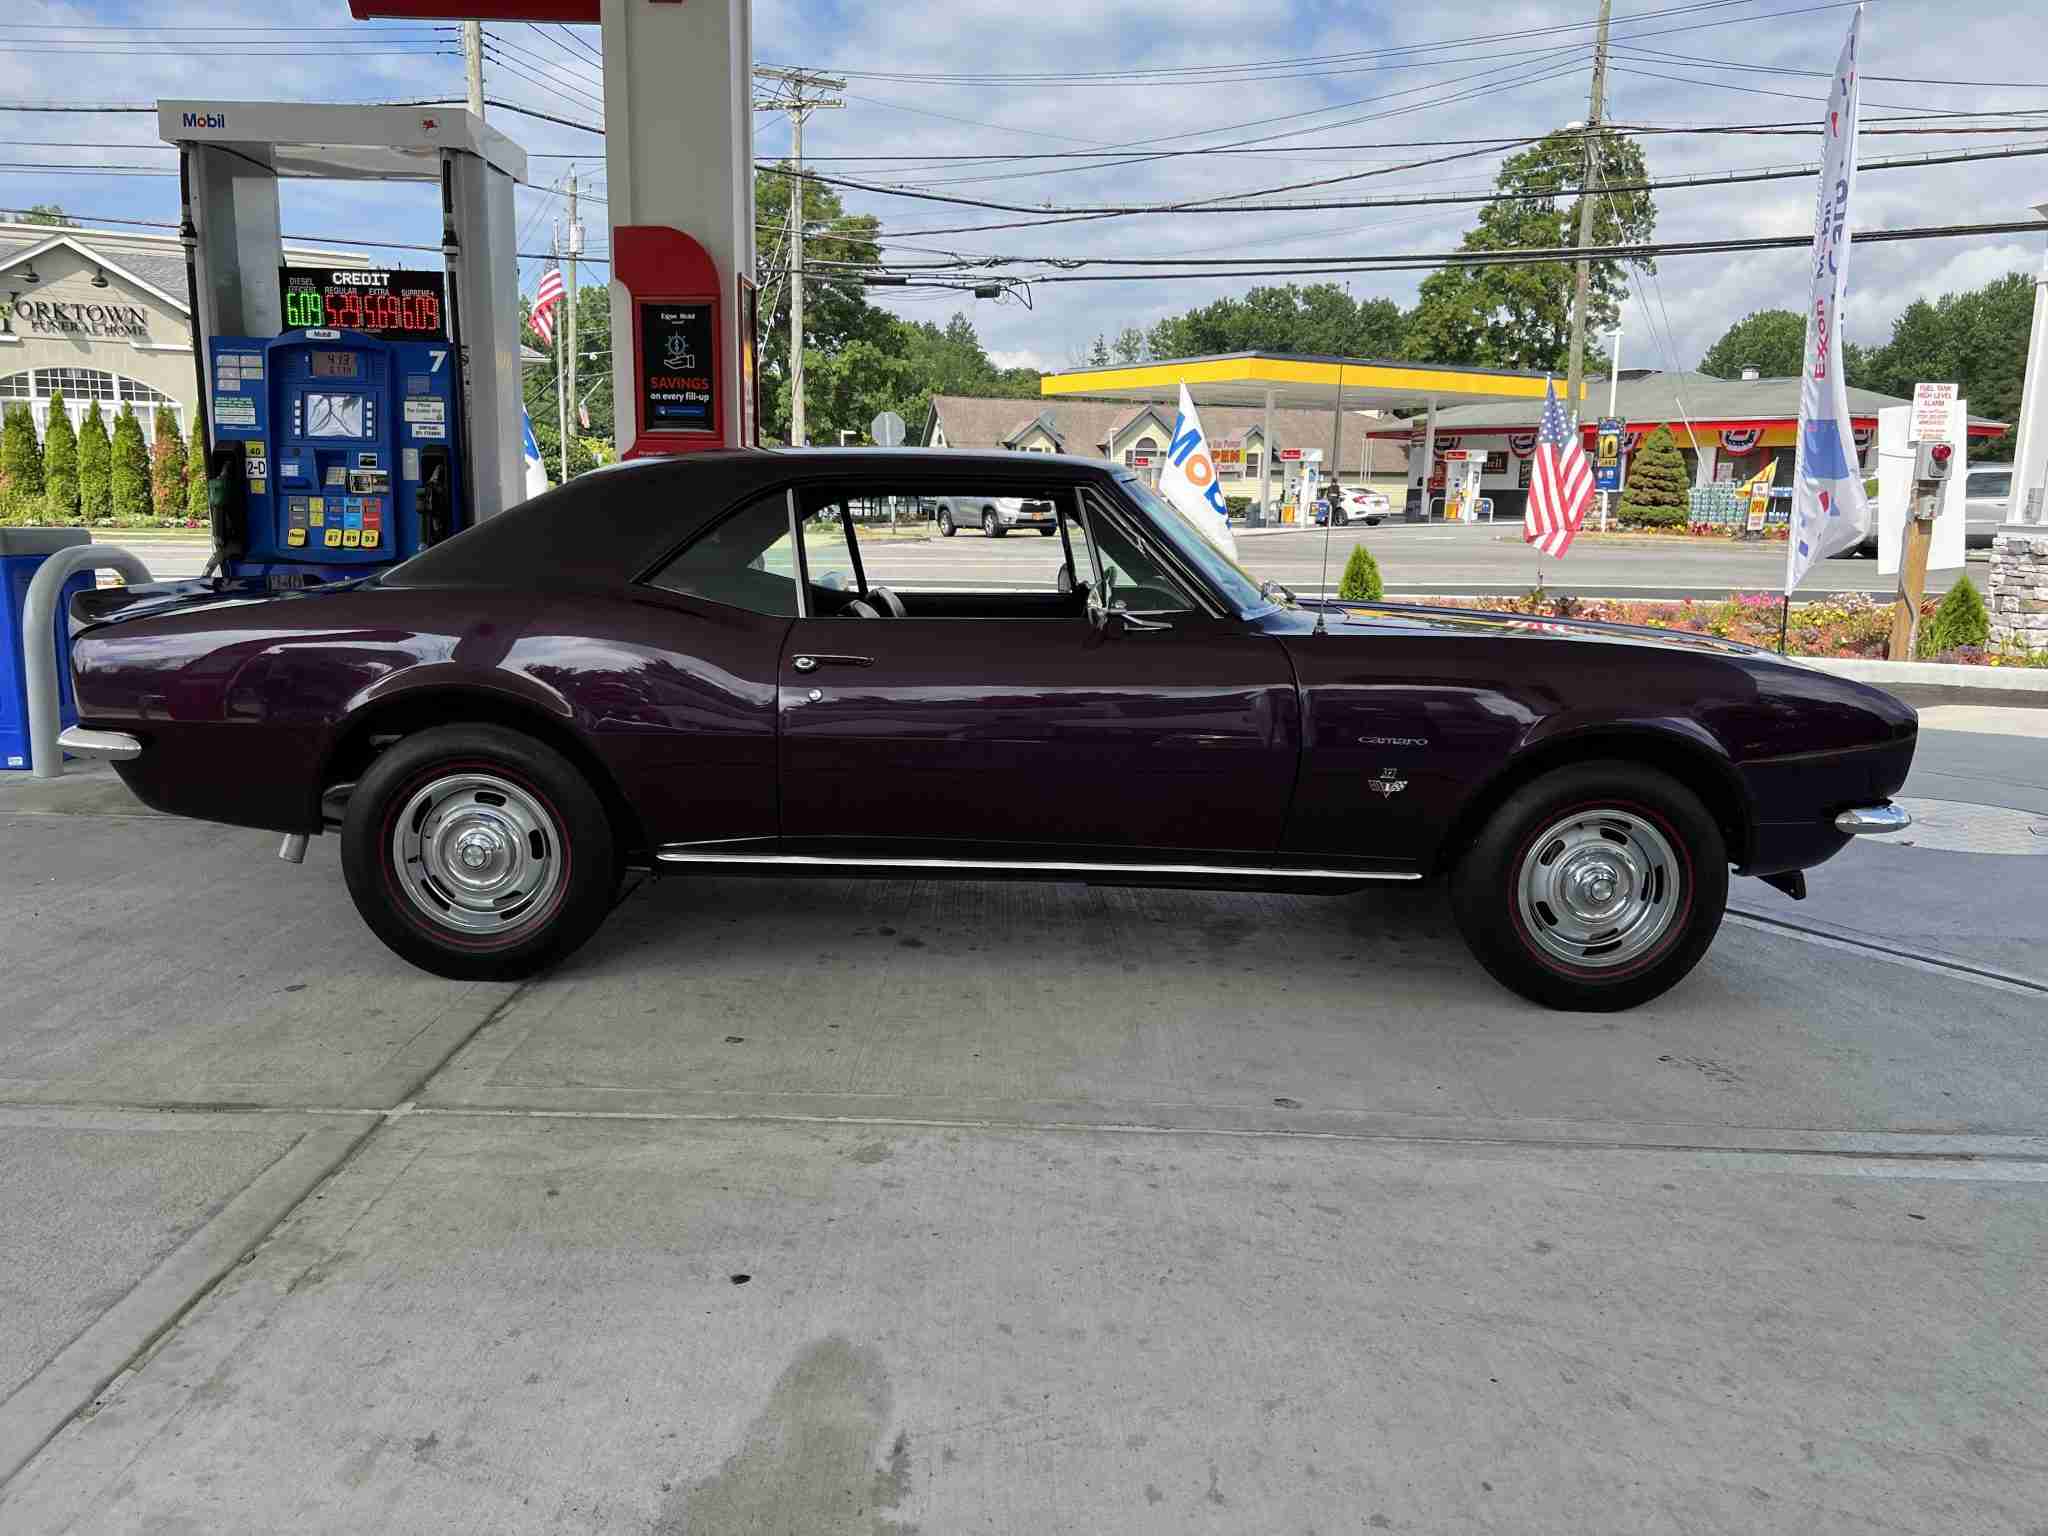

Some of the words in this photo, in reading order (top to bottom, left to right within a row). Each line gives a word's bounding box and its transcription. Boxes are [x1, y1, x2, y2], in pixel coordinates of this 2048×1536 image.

[182, 112, 225, 129] Mobil
[332, 272, 390, 286] CREDIT
[325, 286, 358, 295] REGULAR
[369, 288, 390, 296] EXTRA
[287, 293, 321, 326] 6.09
[32, 319, 101, 336] FUNERAL
[103, 324, 149, 337] HOME
[429, 350, 448, 373] 7
[650, 376, 710, 390] SAVINGS
[650, 392, 660, 400] on
[662, 392, 684, 402] every
[685, 390, 710, 402] fill-up
[247, 461, 266, 474] 2-D
[1358, 736, 1428, 746] Camaro
